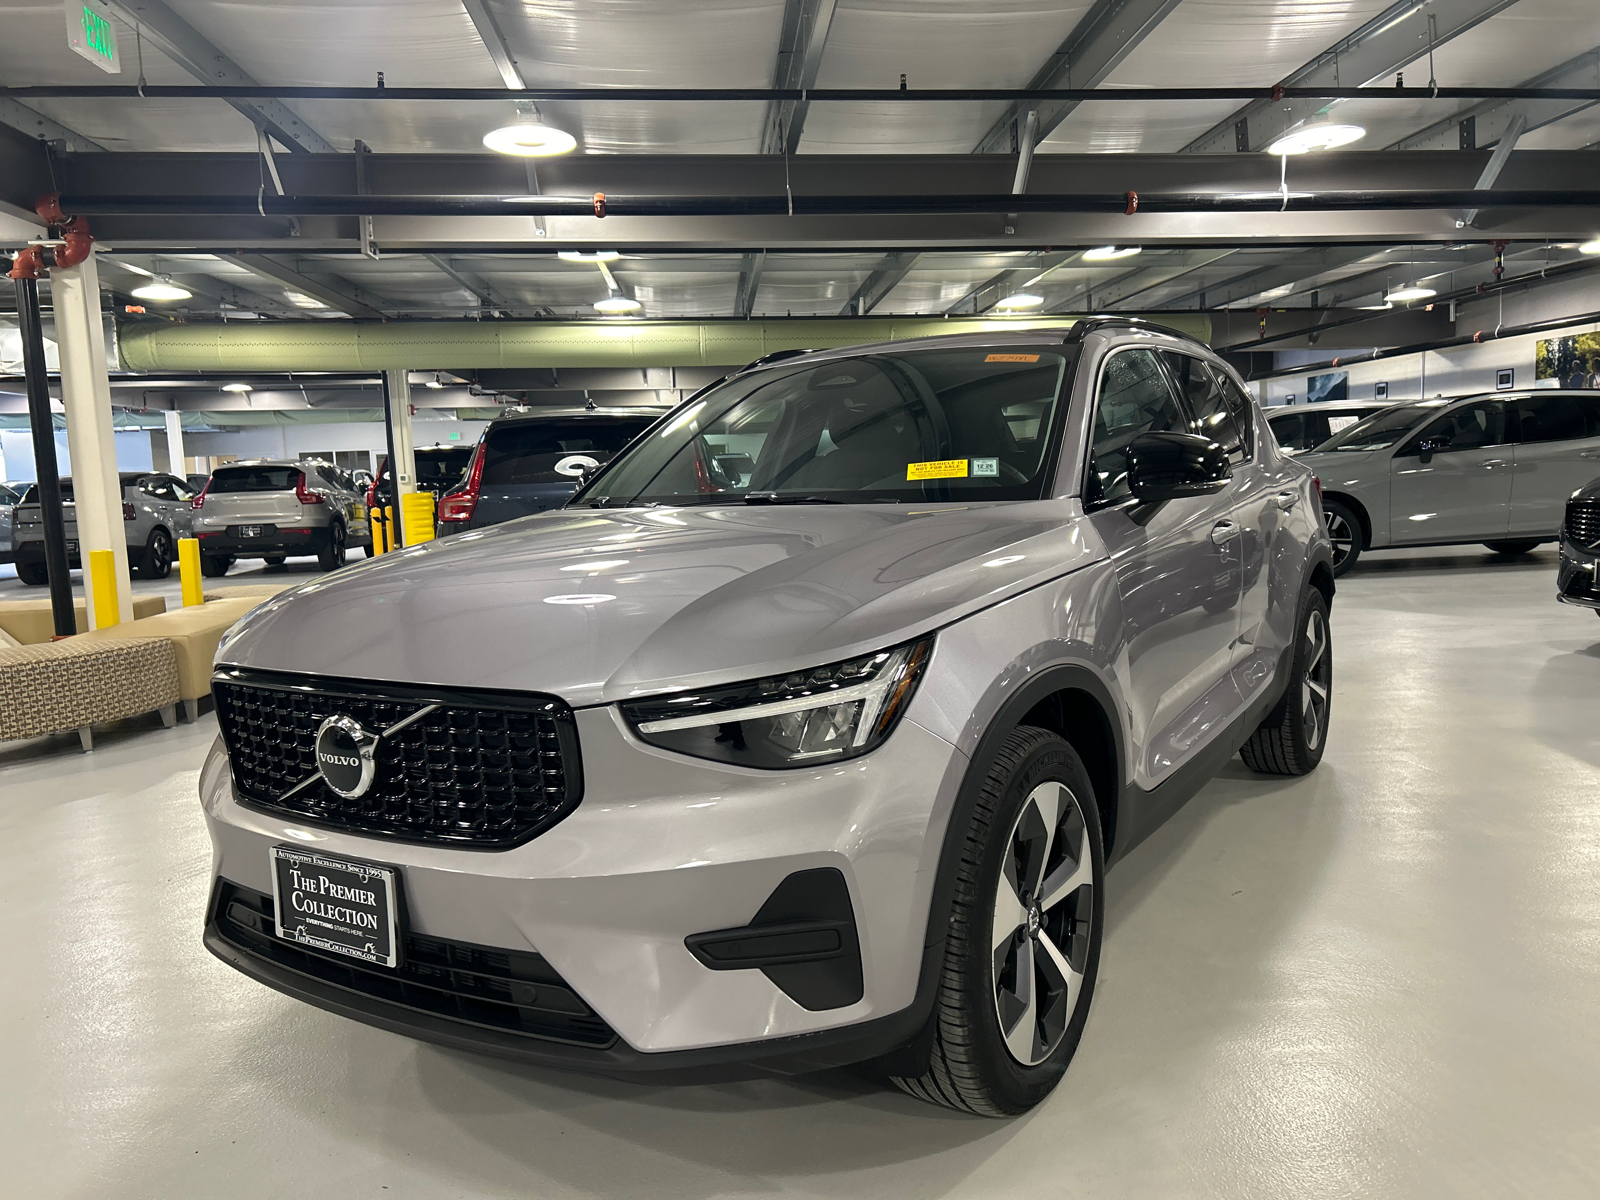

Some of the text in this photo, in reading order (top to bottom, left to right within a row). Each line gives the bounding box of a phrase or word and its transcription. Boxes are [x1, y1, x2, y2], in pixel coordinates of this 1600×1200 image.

[83, 5, 112, 61] EXIT
[319, 752, 360, 767] VOLVO
[278, 850, 382, 878] AUTOMOTIVE EXCELLENCE SINCE 1995
[289, 869, 377, 907] THE PREMIER
[291, 890, 378, 930] COLLECTION
[305, 917, 334, 929] EVERYTHING
[333, 924, 351, 934] STARTS
